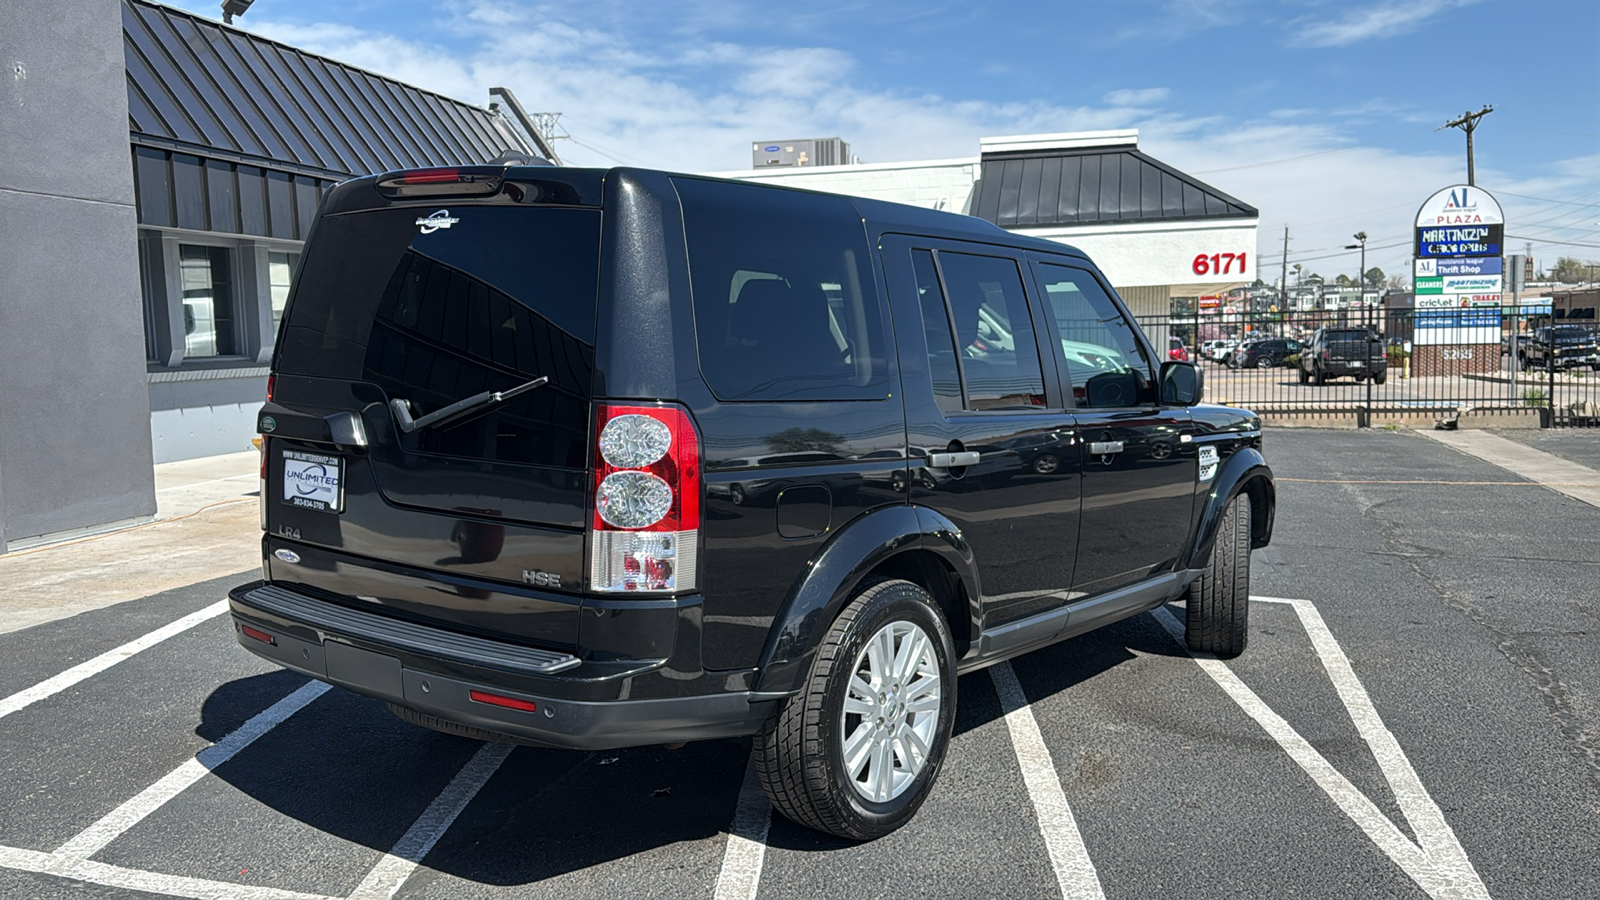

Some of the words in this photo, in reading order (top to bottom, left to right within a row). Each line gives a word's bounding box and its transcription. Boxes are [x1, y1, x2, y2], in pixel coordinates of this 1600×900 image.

[1444, 188, 1477, 208] AL
[1437, 214, 1482, 224] PLAZA
[1192, 252, 1246, 276] 6171
[1438, 266, 1459, 274] Thrift
[1460, 265, 1481, 274] Shop
[1416, 281, 1443, 289] CLEANERS
[1419, 298, 1453, 307] cricket
[287, 470, 338, 485] UNLIMITED
[279, 524, 301, 540] LR4
[522, 569, 561, 588] HSE
